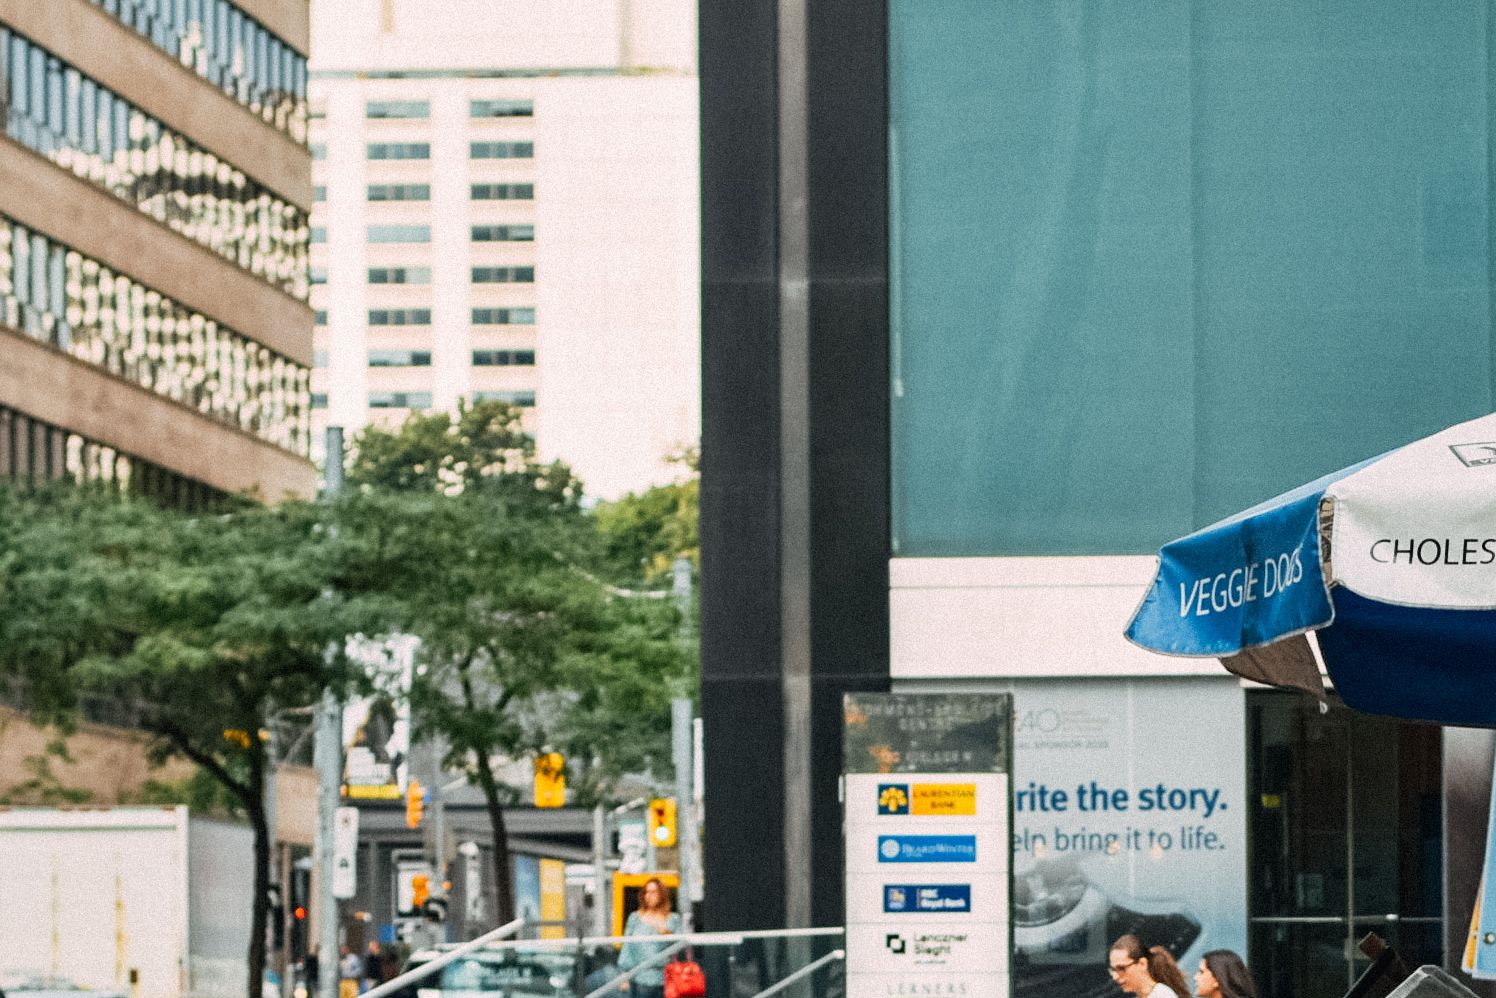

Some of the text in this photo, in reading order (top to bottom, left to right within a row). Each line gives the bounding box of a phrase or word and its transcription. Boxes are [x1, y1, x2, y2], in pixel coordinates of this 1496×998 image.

[1180, 563, 1258, 617] VEGGIE
[1017, 781, 1228, 818] rite the story.
[1014, 825, 1225, 857] elp bring it to life.
